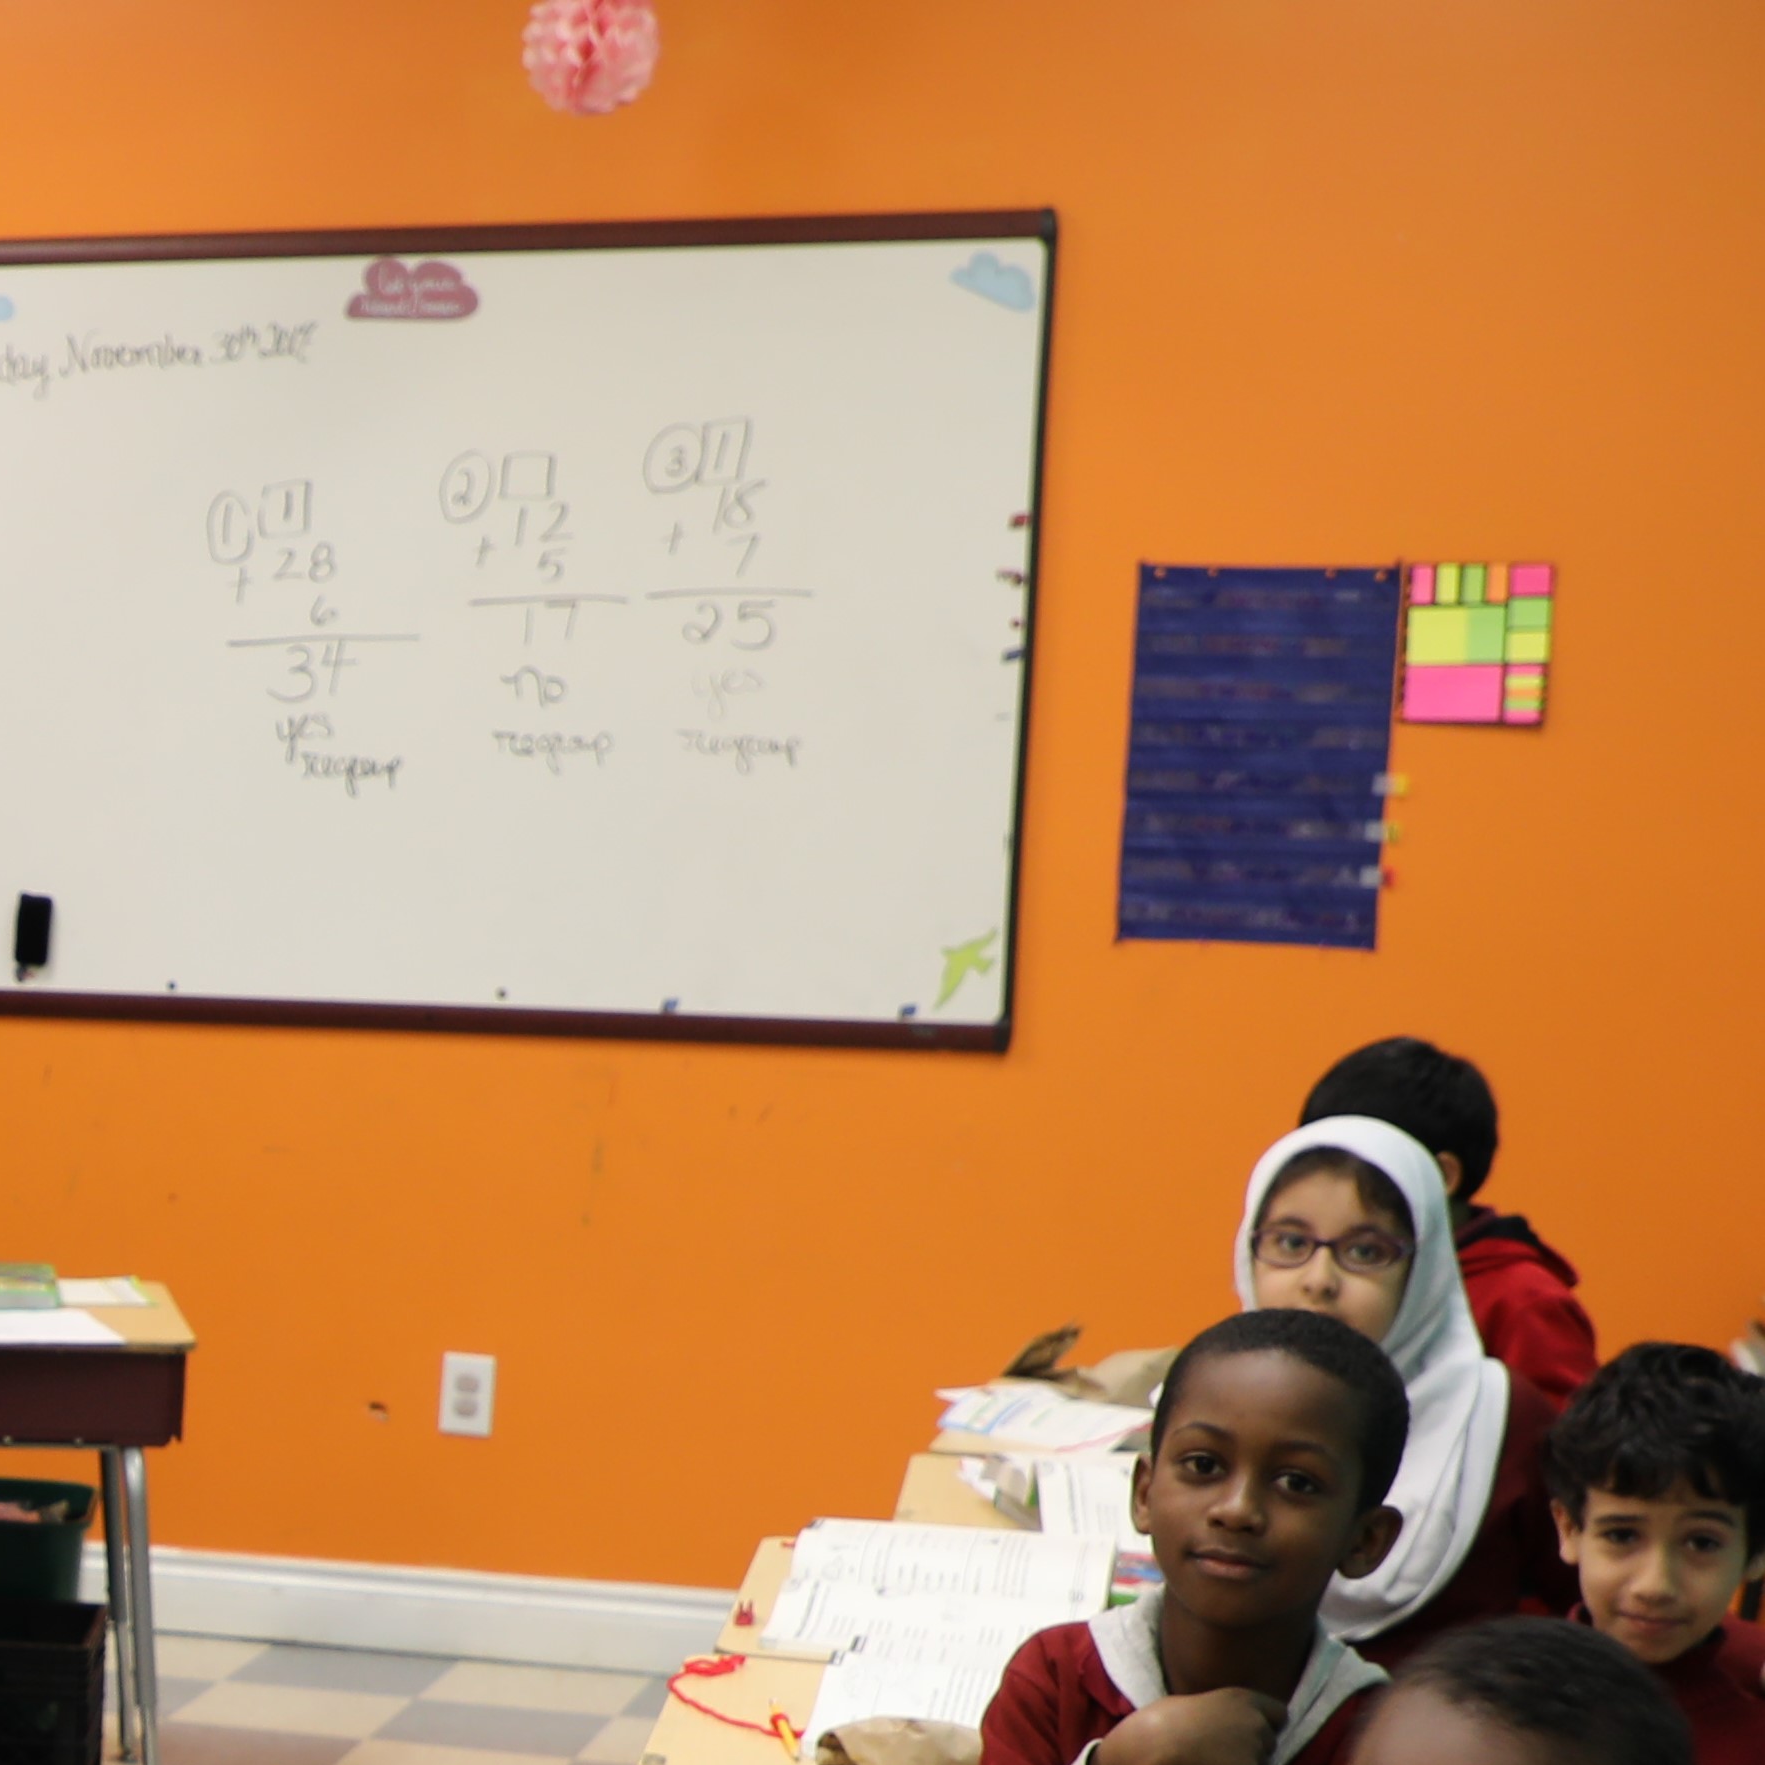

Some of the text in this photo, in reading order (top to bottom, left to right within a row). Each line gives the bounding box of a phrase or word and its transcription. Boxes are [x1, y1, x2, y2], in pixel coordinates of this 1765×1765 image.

[515, 502, 574, 548] 12
[274, 541, 336, 584] 28
[536, 546, 567, 583] 5
[308, 595, 337, 628] 6
[523, 600, 579, 645] 17
[682, 597, 776, 652] 25
[266, 639, 359, 702] 34
[498, 664, 567, 710] no
[690, 668, 765, 718] yes
[274, 712, 335, 763] yes
